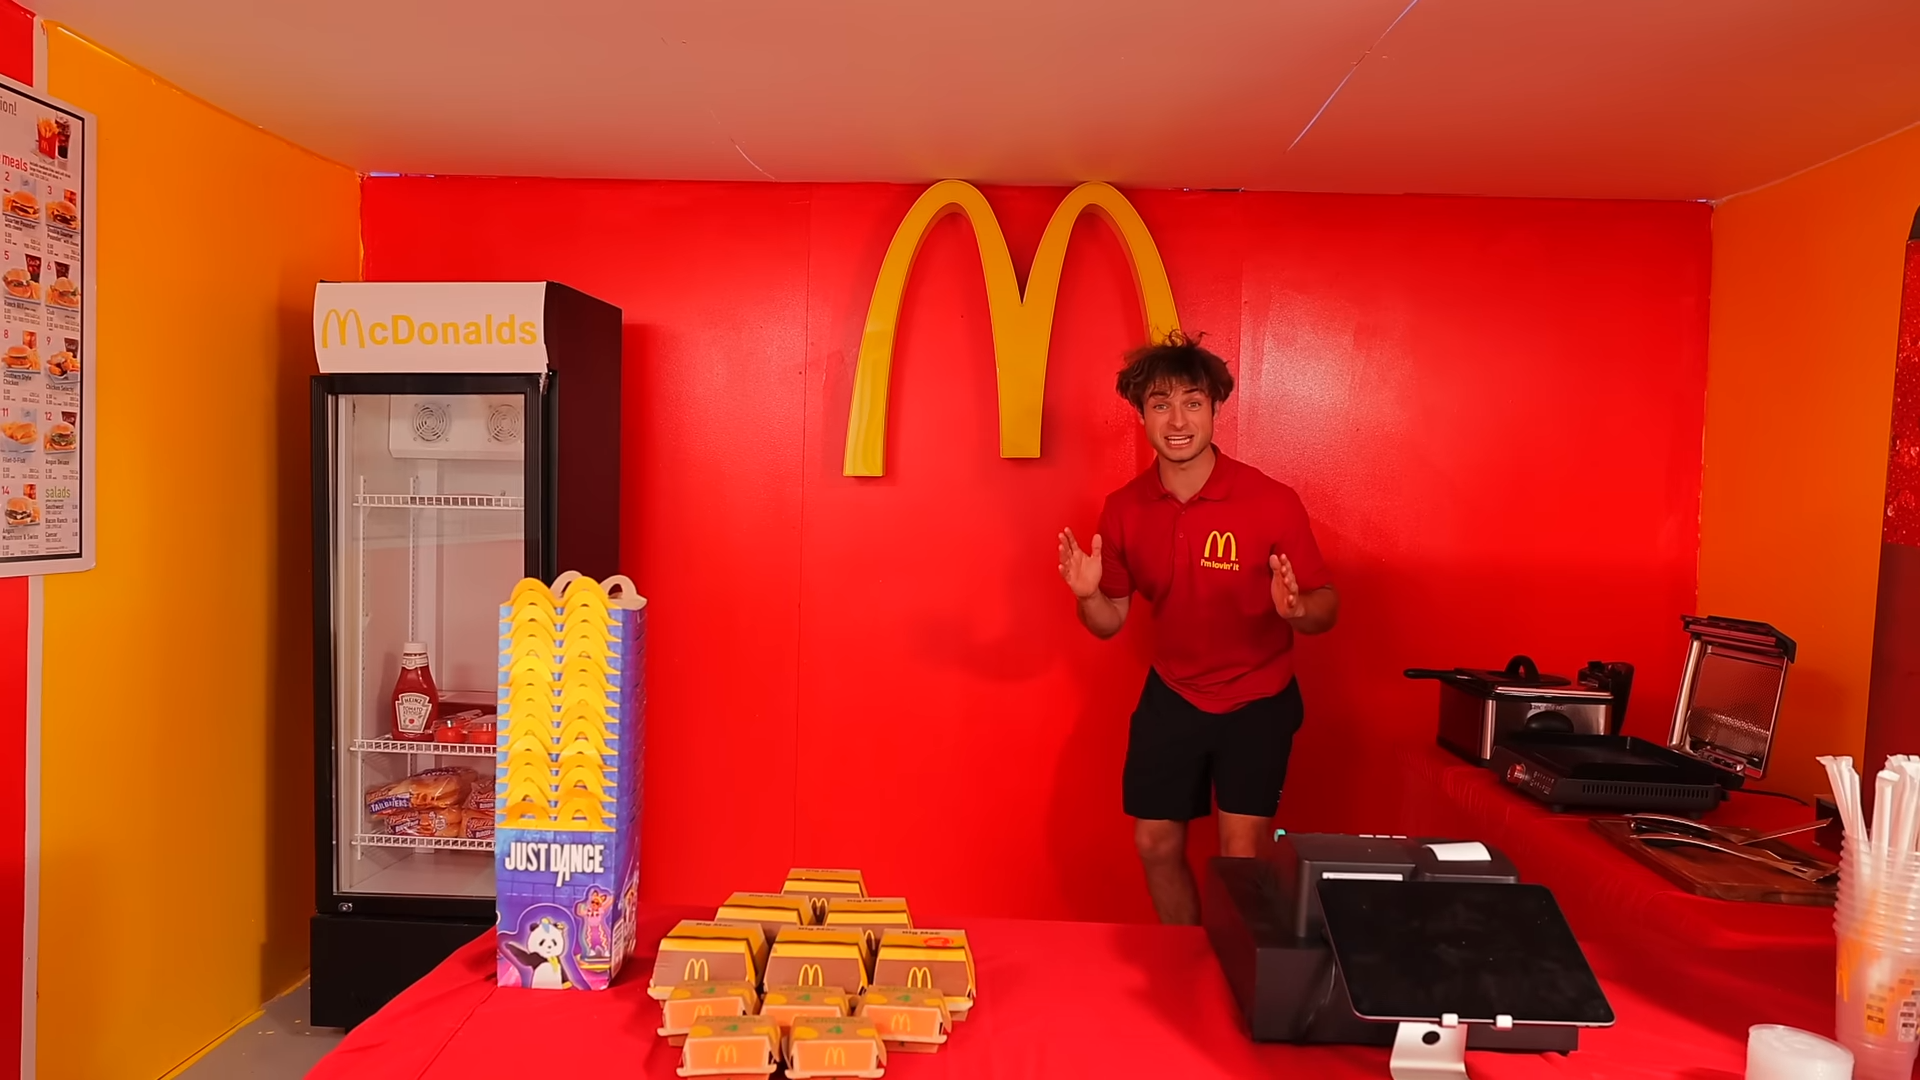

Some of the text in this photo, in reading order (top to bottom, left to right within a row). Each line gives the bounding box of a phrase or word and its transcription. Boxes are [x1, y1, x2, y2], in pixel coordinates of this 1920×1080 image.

[2, 154, 28, 172] meals
[5, 171, 10, 181] 2
[47, 185, 53, 195] 3
[4, 251, 9, 260] 5
[46, 261, 52, 271] 6
[321, 308, 538, 348] McDonalds
[3, 329, 9, 339] 8
[46, 336, 52, 346] 9
[2, 408, 9, 417] 11
[45, 411, 52, 421] 12
[2, 486, 10, 495] 14
[45, 486, 71, 498] salads
[504, 841, 604, 887] JUST DANCE
